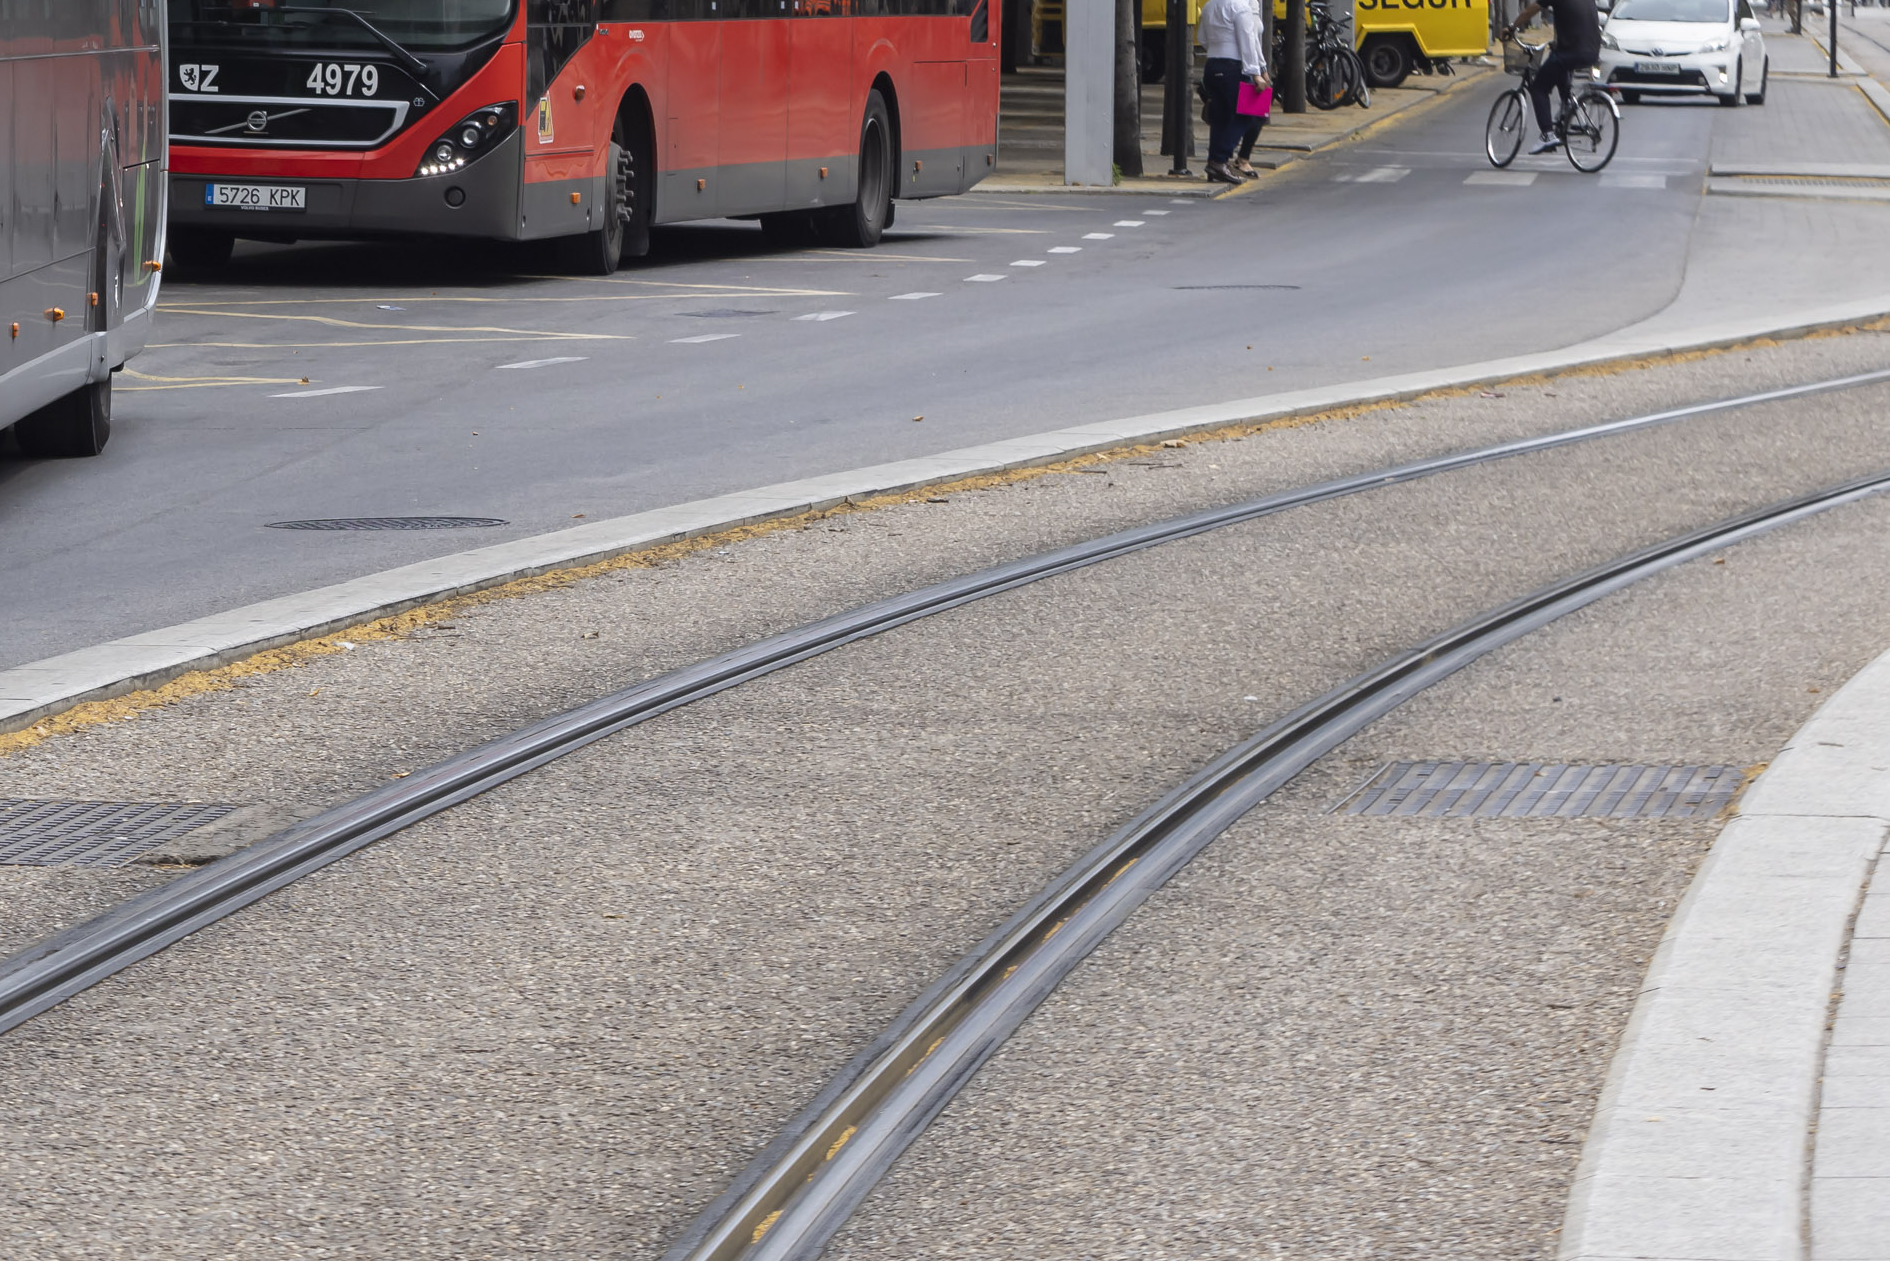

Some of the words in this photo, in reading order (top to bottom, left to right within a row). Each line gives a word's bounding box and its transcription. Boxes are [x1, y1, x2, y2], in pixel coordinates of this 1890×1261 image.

[306, 63, 379, 96] 4979
[219, 186, 260, 205] 5726
[269, 188, 300, 206] KPK
